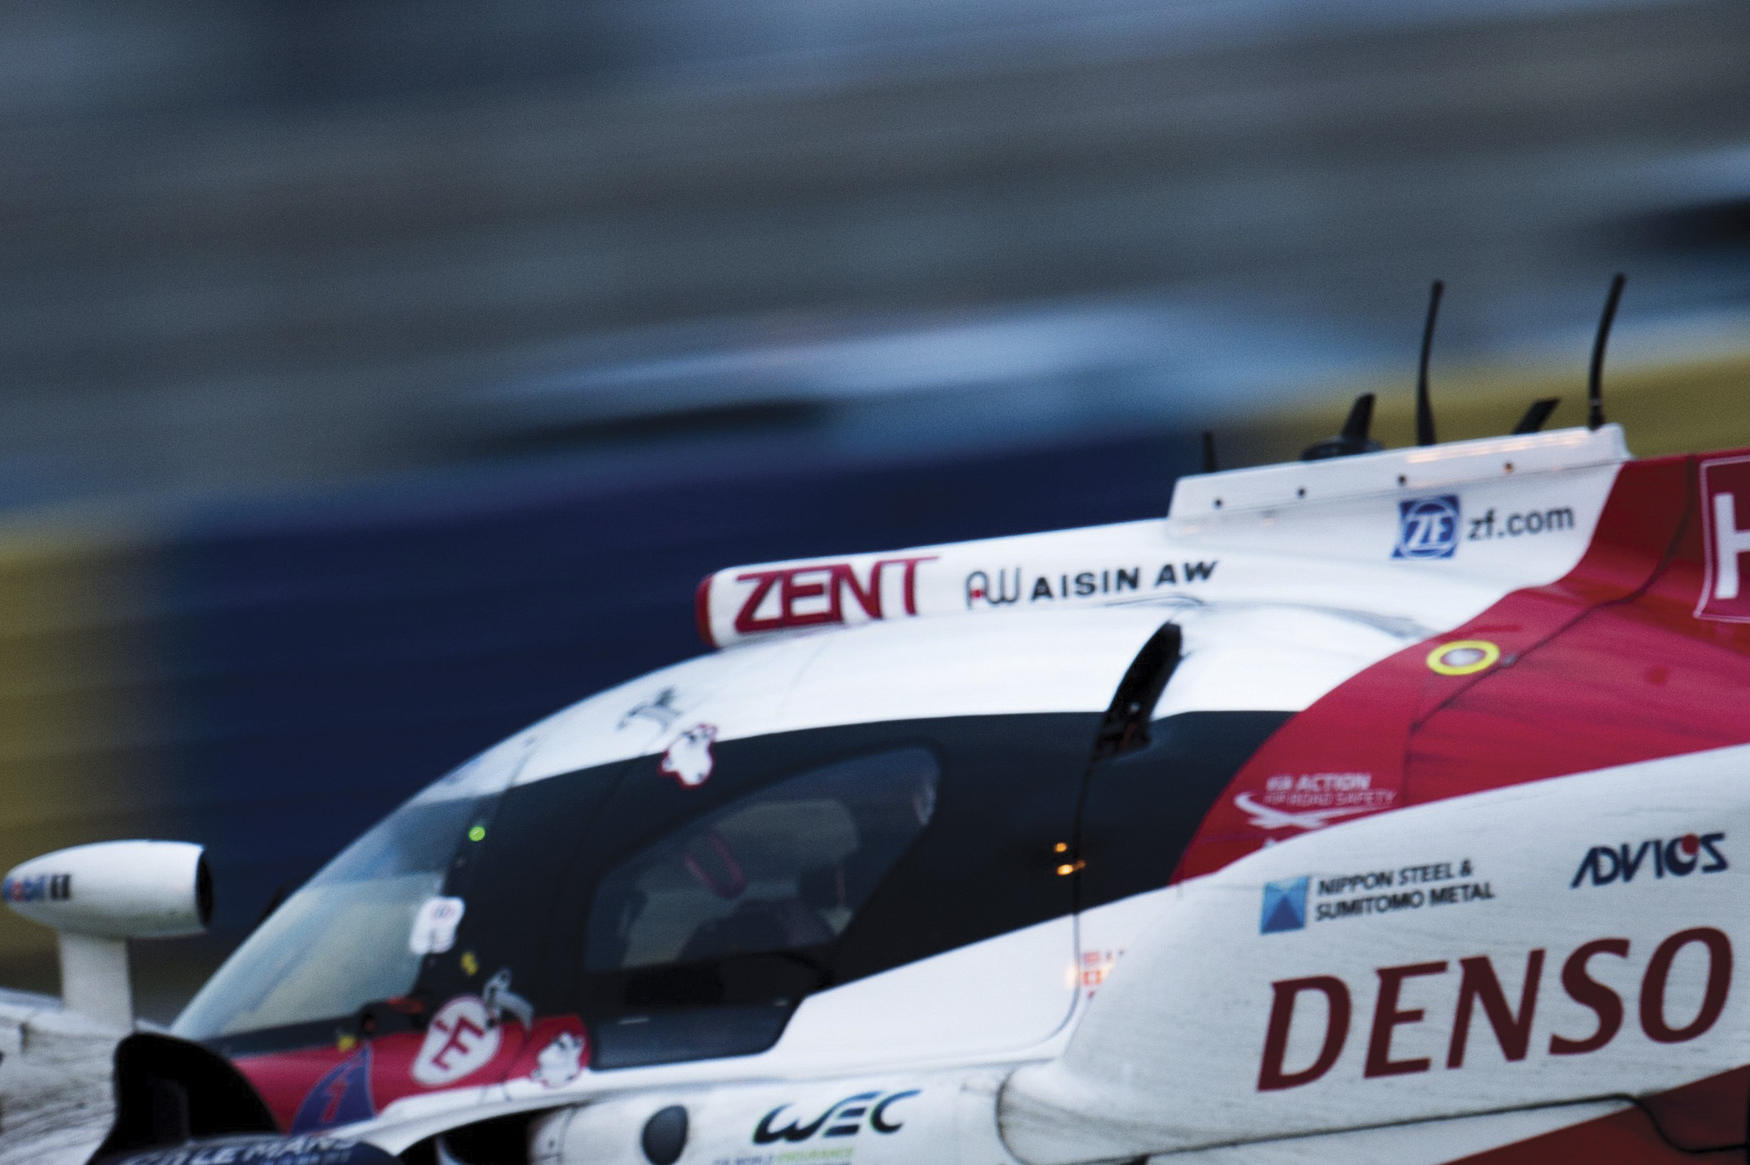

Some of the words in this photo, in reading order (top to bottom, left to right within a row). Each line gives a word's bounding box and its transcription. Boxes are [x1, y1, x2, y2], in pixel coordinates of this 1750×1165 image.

[1466, 507, 1575, 541] zf.com
[734, 556, 940, 634] ZENT
[1030, 566, 1141, 601] AISIN
[1154, 560, 1218, 587] AW
[1296, 772, 1372, 792] ACTION
[1317, 870, 1394, 896] NIPPON
[1397, 862, 1454, 886] STEEL
[1459, 858, 1474, 877] &
[1570, 832, 1728, 889] ADVICS
[1315, 890, 1426, 922] SUMITOMO
[1429, 881, 1496, 907] METAL
[1256, 926, 1734, 1092] DENSO
[752, 1089, 924, 1145] WEC
